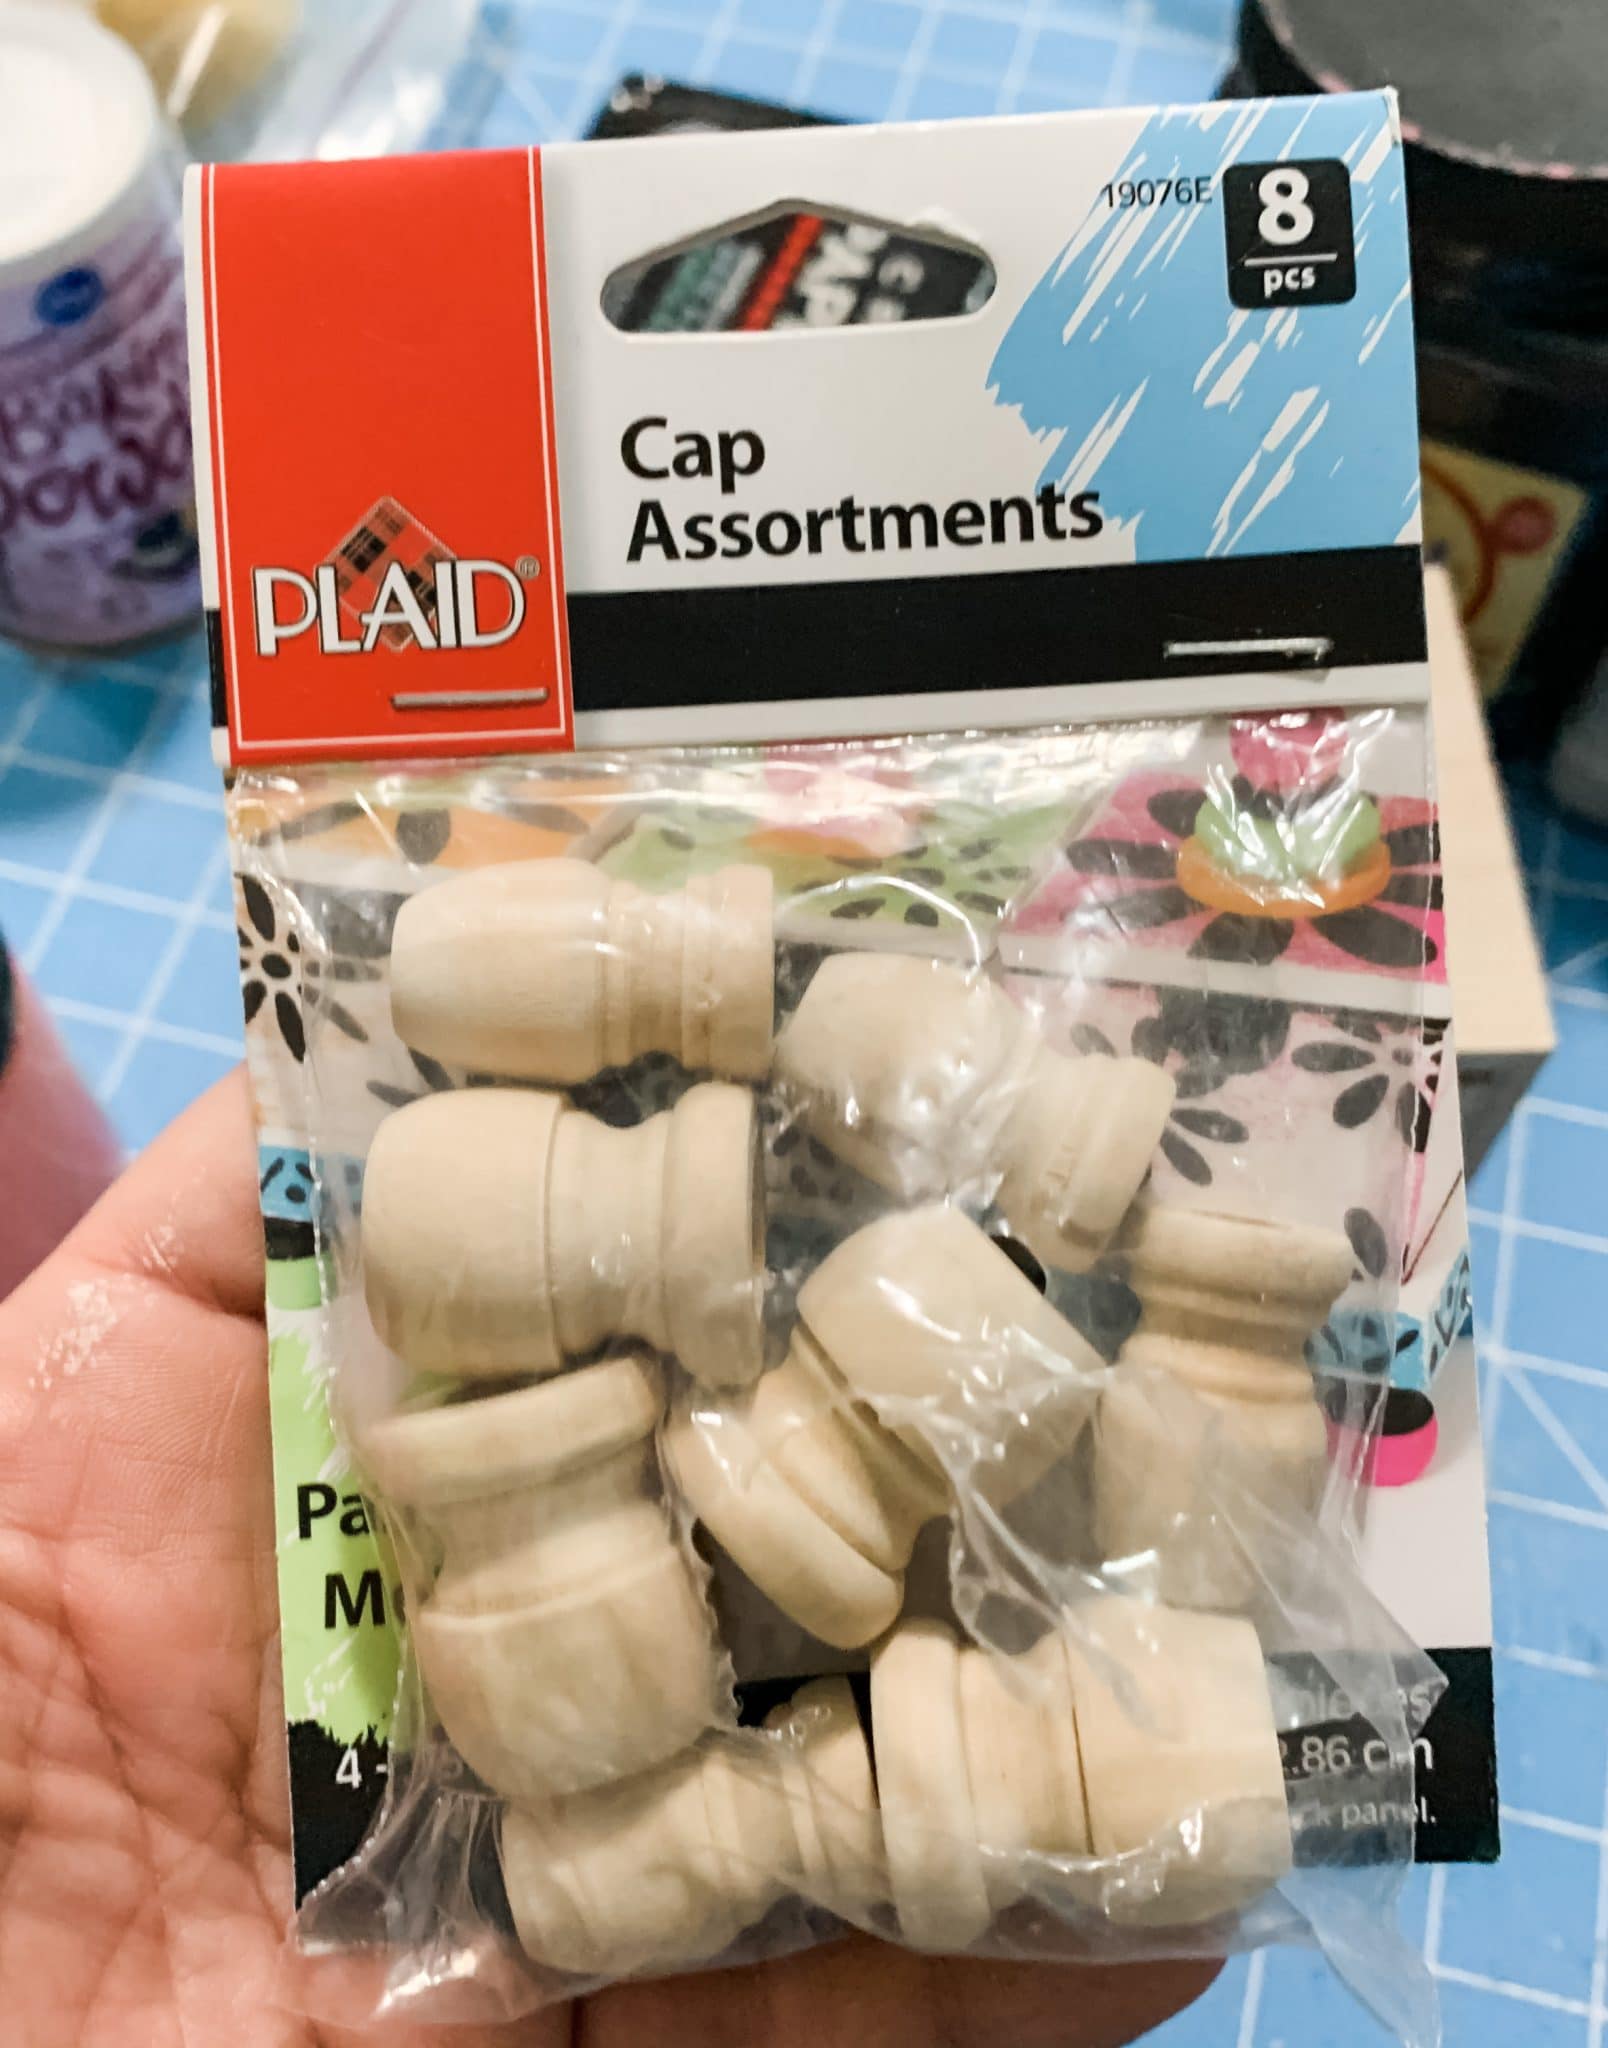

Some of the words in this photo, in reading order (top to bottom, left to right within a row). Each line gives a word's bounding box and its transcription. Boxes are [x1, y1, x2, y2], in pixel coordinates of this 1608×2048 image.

[1101, 176, 1213, 208] 19076E
[1257, 168, 1315, 245] 8
[1263, 266, 1316, 299] pcs
[620, 416, 766, 495] Cap
[626, 482, 1104, 563] Assortments
